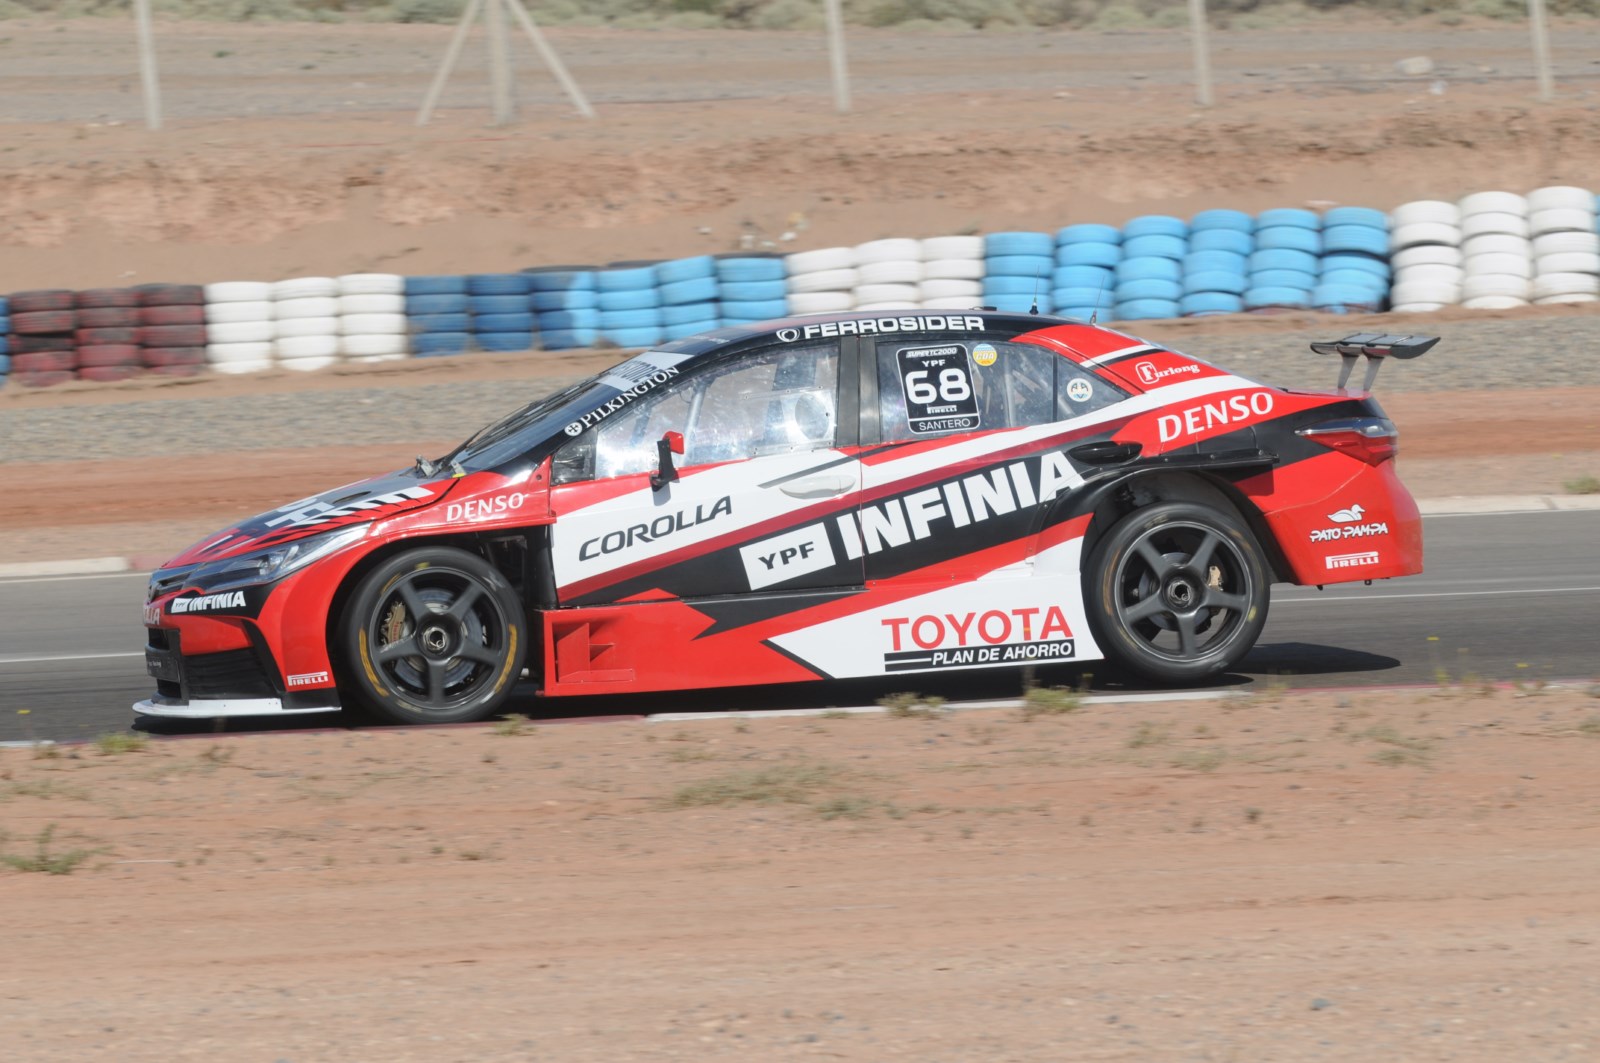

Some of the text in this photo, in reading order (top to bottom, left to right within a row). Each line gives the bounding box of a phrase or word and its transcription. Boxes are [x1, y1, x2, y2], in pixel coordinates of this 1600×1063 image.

[804, 316, 985, 339] FERROSIDER
[922, 359, 945, 367] YPF
[1138, 364, 1201, 382] Furlong
[580, 366, 679, 428] PILKINGTON
[905, 368, 970, 404] 68
[927, 405, 957, 414] PIRELLI
[1158, 392, 1273, 442] DENSO
[919, 418, 970, 430] SANTERO
[446, 492, 524, 522] DENSO
[758, 451, 1087, 570] YPF INFINIA
[579, 495, 732, 561] COROLLA
[1309, 522, 1388, 542] PATO PAMPA
[1325, 551, 1379, 569] PIRELLI
[189, 591, 246, 611] INFINIA
[881, 606, 1073, 651] TOYOTA
[932, 642, 1072, 665] PLAN DE AHORRO
[287, 671, 329, 686] PIRELLI
